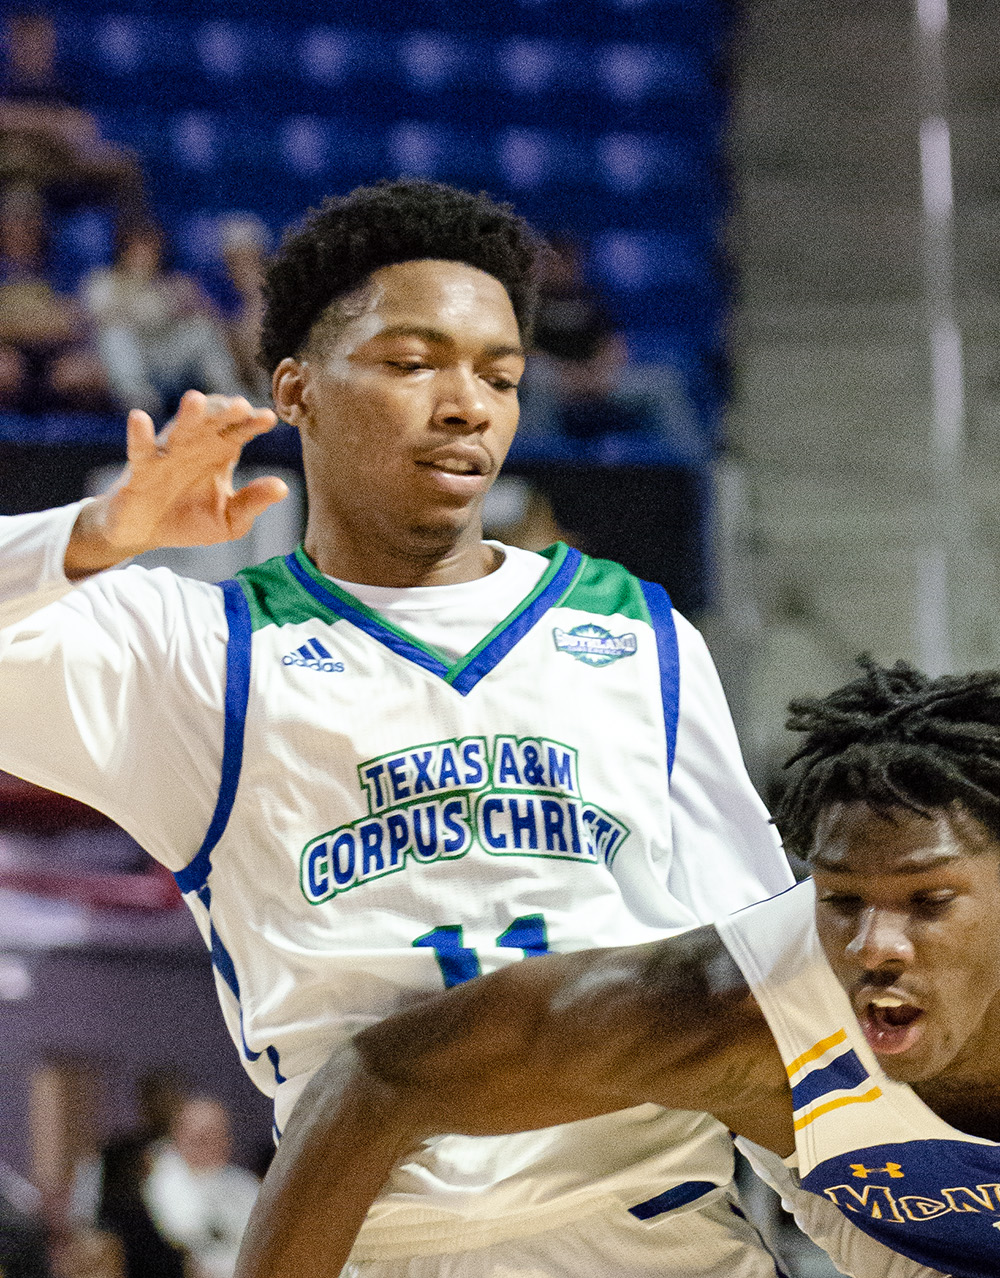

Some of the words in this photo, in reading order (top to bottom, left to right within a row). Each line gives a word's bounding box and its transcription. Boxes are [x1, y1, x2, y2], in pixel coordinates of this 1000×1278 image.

[363, 741, 487, 810] TEXAS
[498, 740, 575, 792] A&M
[306, 799, 468, 900] CORPUS
